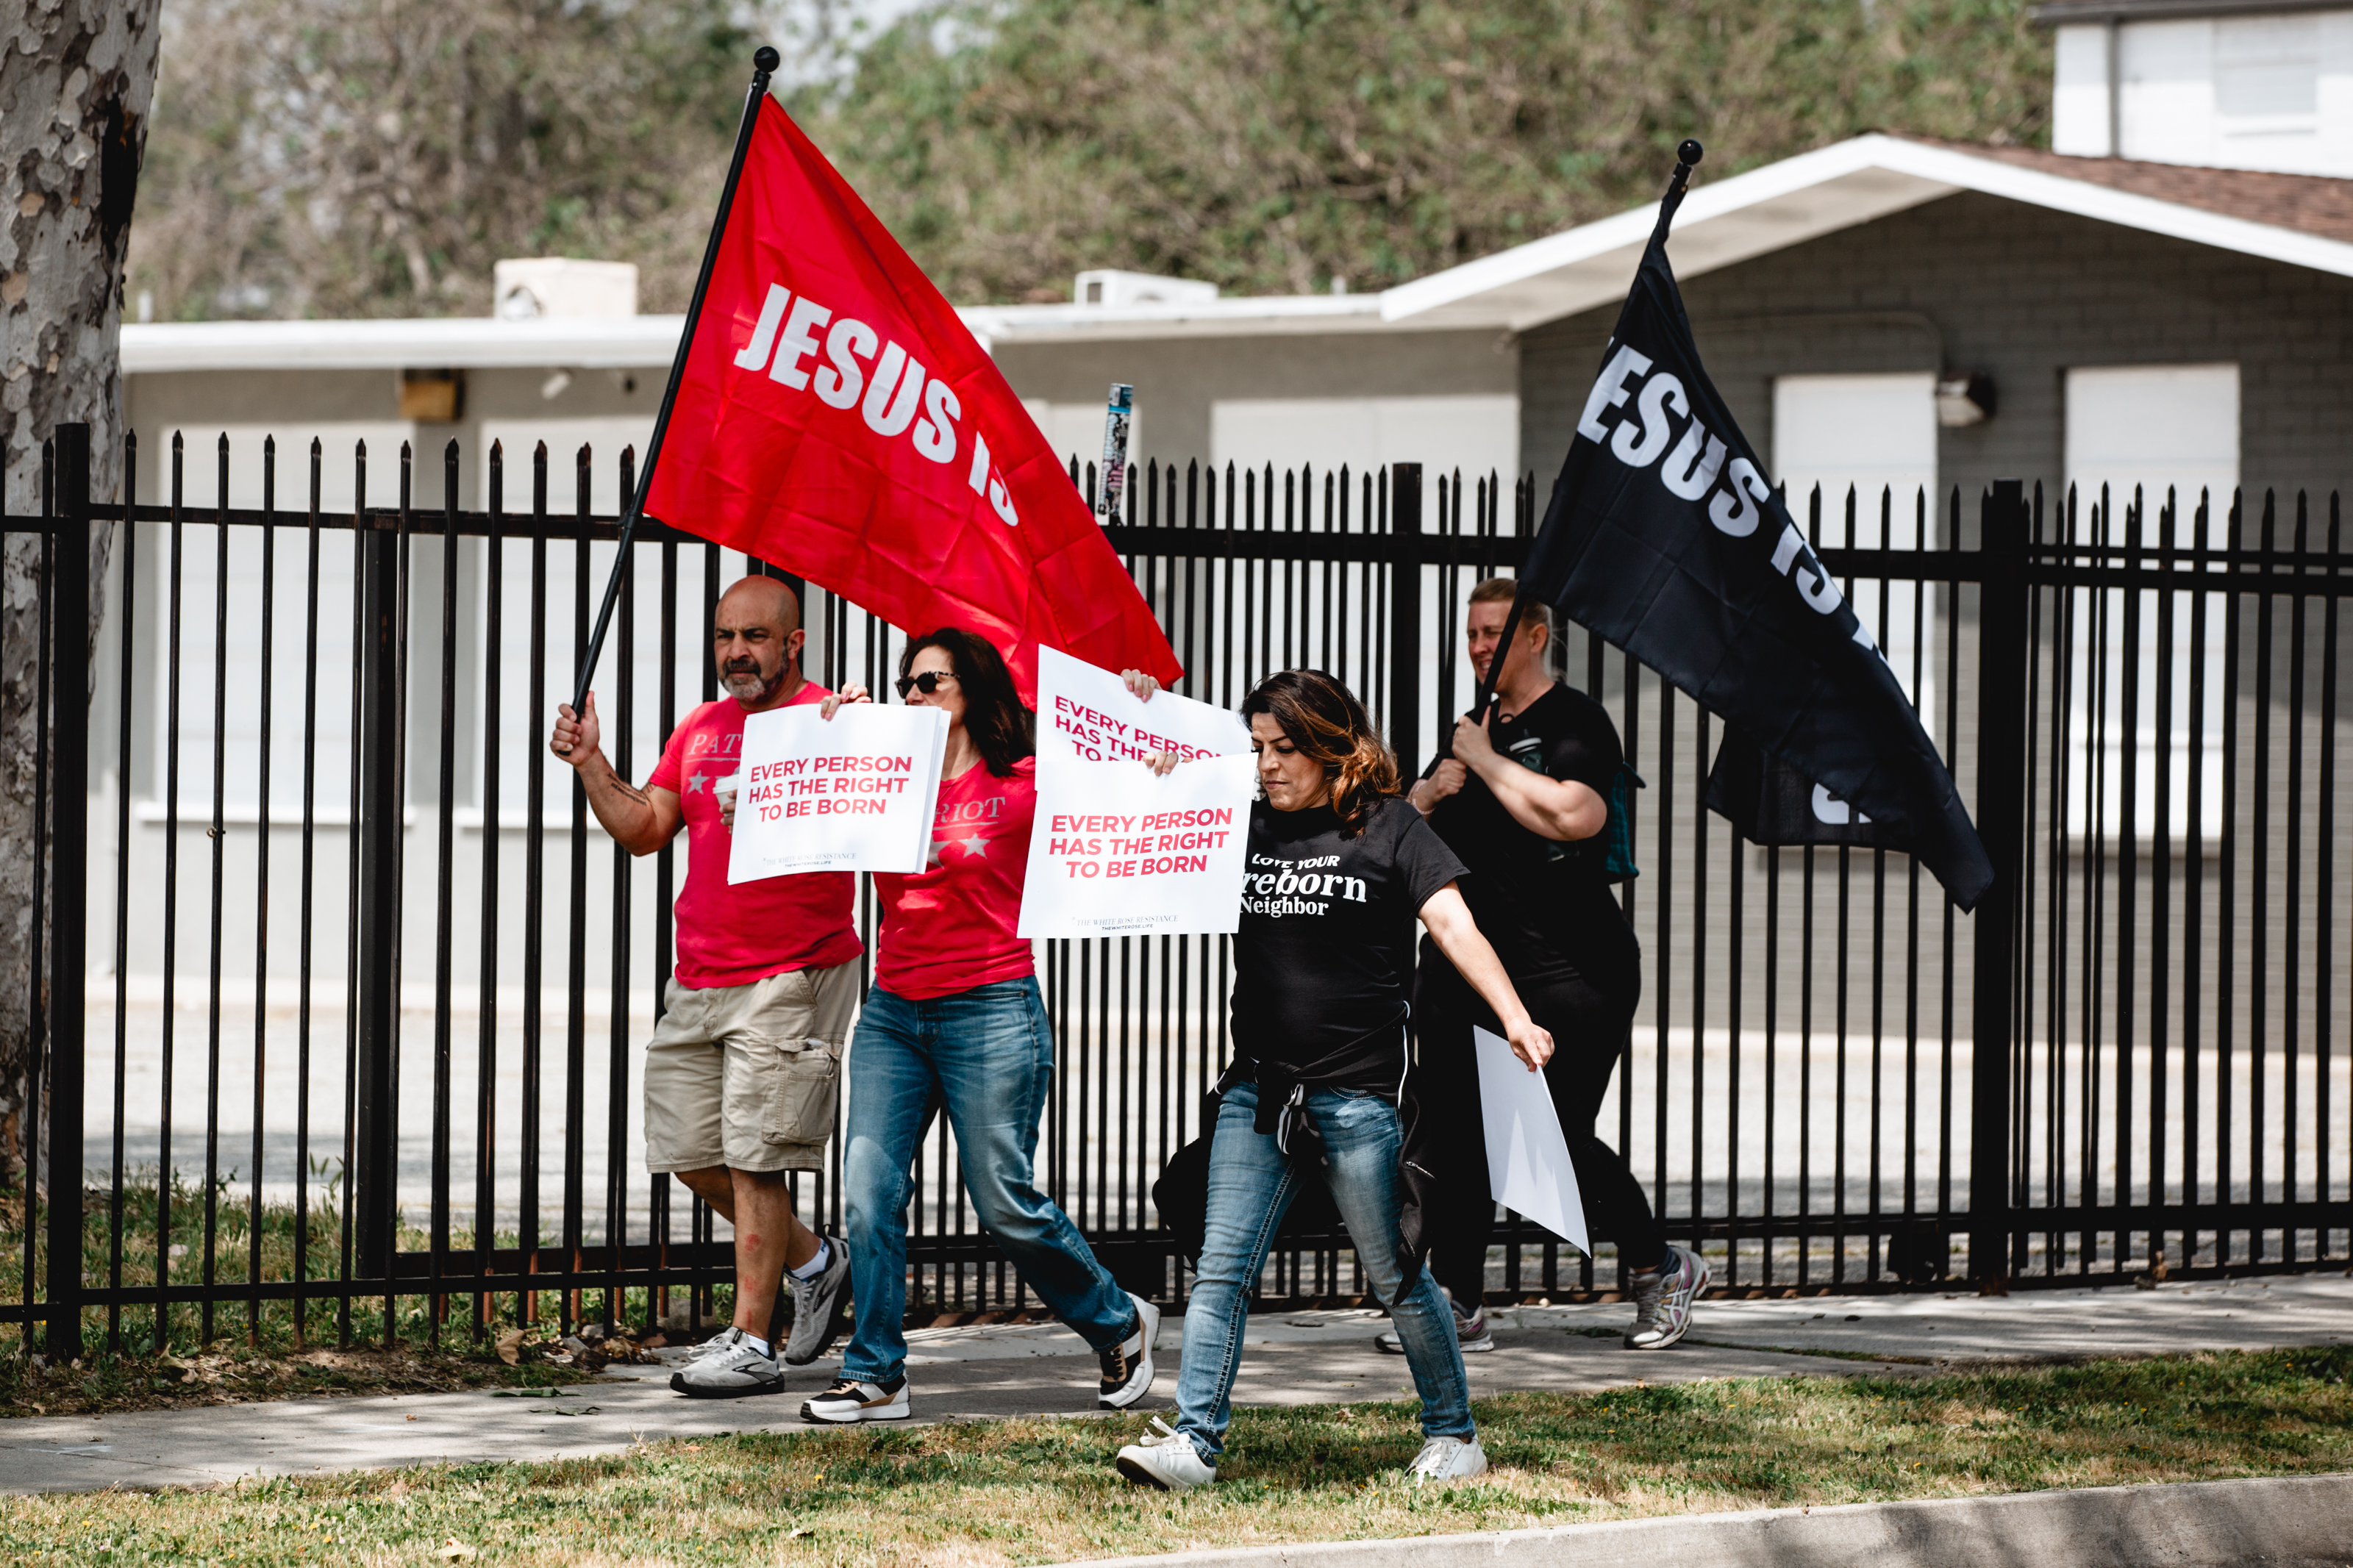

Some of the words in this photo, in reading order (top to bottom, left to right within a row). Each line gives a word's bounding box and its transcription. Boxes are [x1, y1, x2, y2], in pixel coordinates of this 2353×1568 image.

[733, 282, 962, 464] JESUS
[1577, 336, 1771, 537] ESUS
[1056, 695, 1128, 736] EVERY
[1056, 715, 1101, 745] HAS
[688, 734, 742, 755] PAT
[1072, 740, 1101, 761] TO
[751, 758, 809, 782] EVERY
[814, 756, 912, 773] PERSON
[749, 784, 783, 803] HAS
[788, 778, 828, 796] THE
[834, 778, 909, 793] RIGHT
[760, 804, 782, 822] TO
[786, 801, 812, 817] BE
[817, 798, 886, 815] BORN
[1051, 815, 1137, 832] EVERY
[1141, 808, 1232, 831] PERSON
[1049, 838, 1101, 855] HAS
[1110, 837, 1154, 855] THE
[1158, 831, 1229, 851] RIGHT
[1066, 862, 1099, 878] TO
[1106, 860, 1137, 878] BE
[1140, 855, 1207, 875] BORN
[1252, 853, 1294, 868] LOVE
[1297, 855, 1340, 870] YOUR
[1241, 868, 1366, 903] reborn
[1240, 896, 1329, 918] Neighbor
[1118, 917, 1134, 925] ROSE
